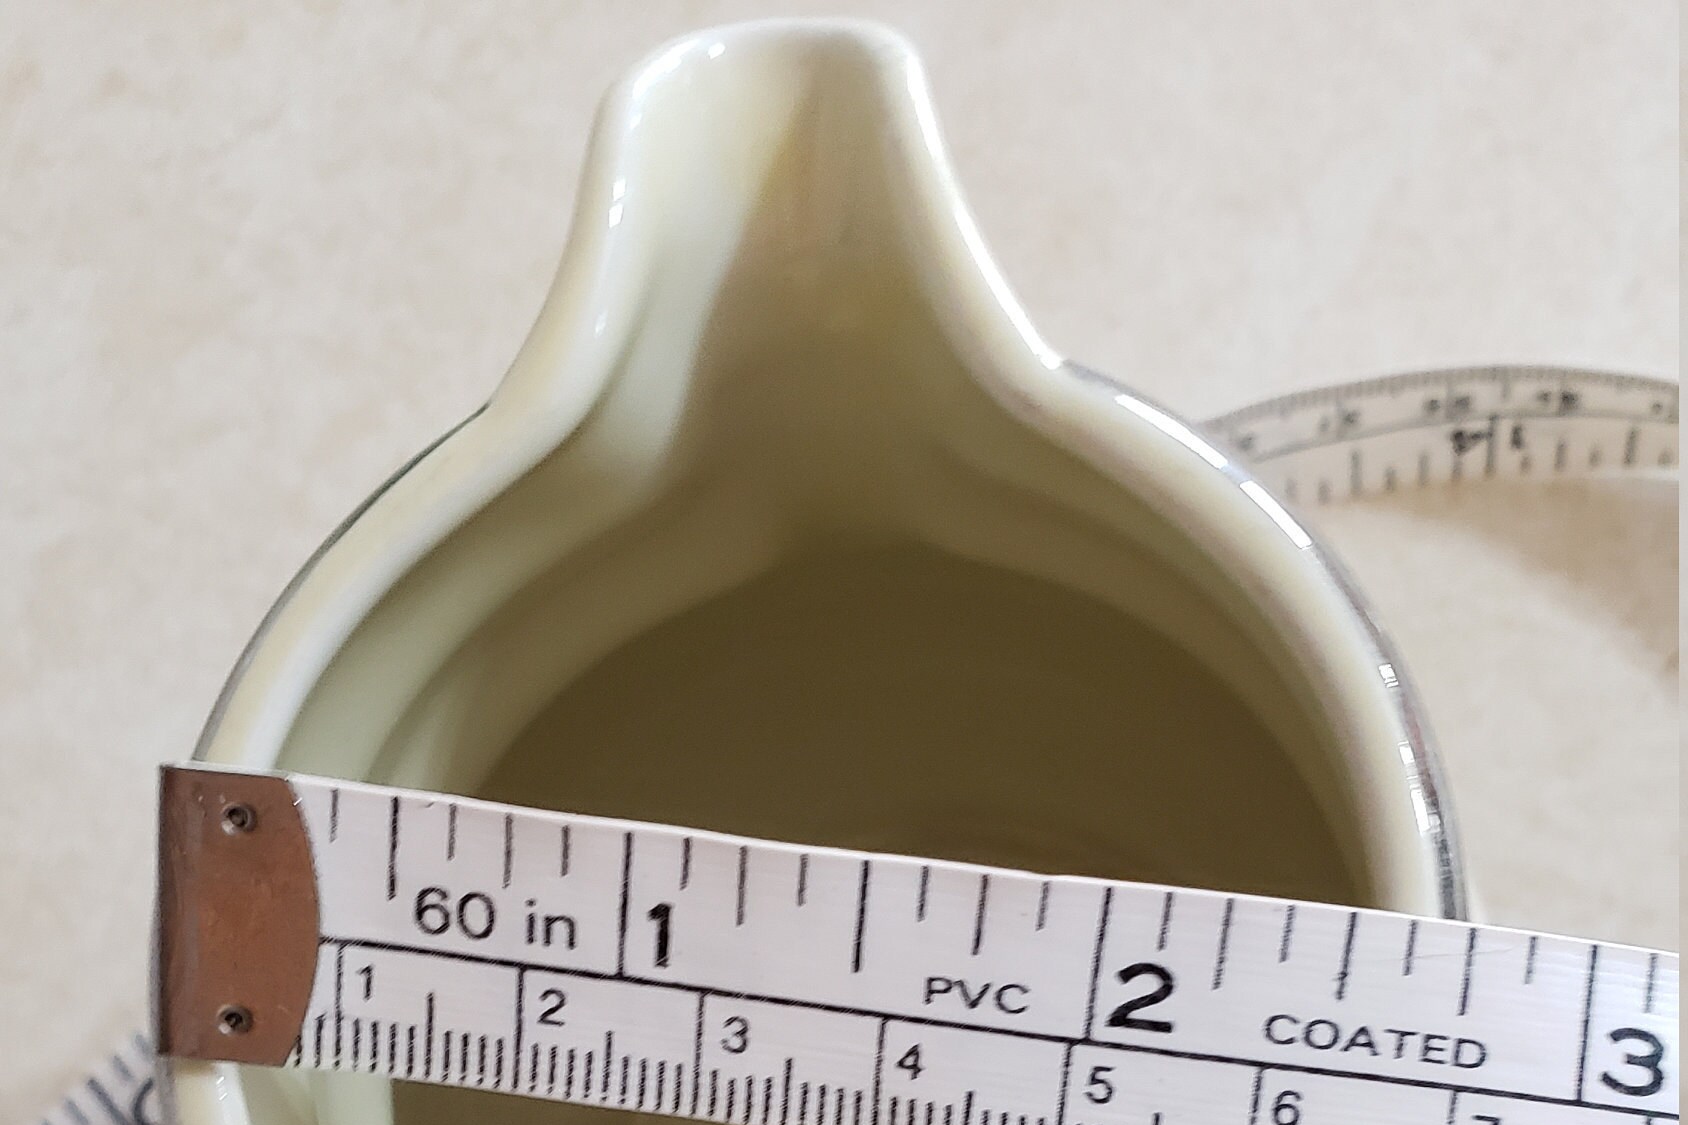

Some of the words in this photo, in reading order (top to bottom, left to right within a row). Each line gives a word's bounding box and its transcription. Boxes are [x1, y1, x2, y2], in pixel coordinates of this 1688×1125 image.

[413, 885, 496, 940] 60
[525, 898, 577, 949] in
[355, 964, 374, 1001] 1
[537, 988, 567, 1027] 2
[719, 1016, 749, 1054] 3
[897, 1044, 925, 1080] 4
[1084, 1066, 1115, 1104] 5
[647, 902, 674, 967] 1
[1105, 963, 1174, 1033] 2
[1601, 1027, 1665, 1096] 3
[924, 976, 1030, 1014] PVC
[1263, 1014, 1488, 1069] COATED
